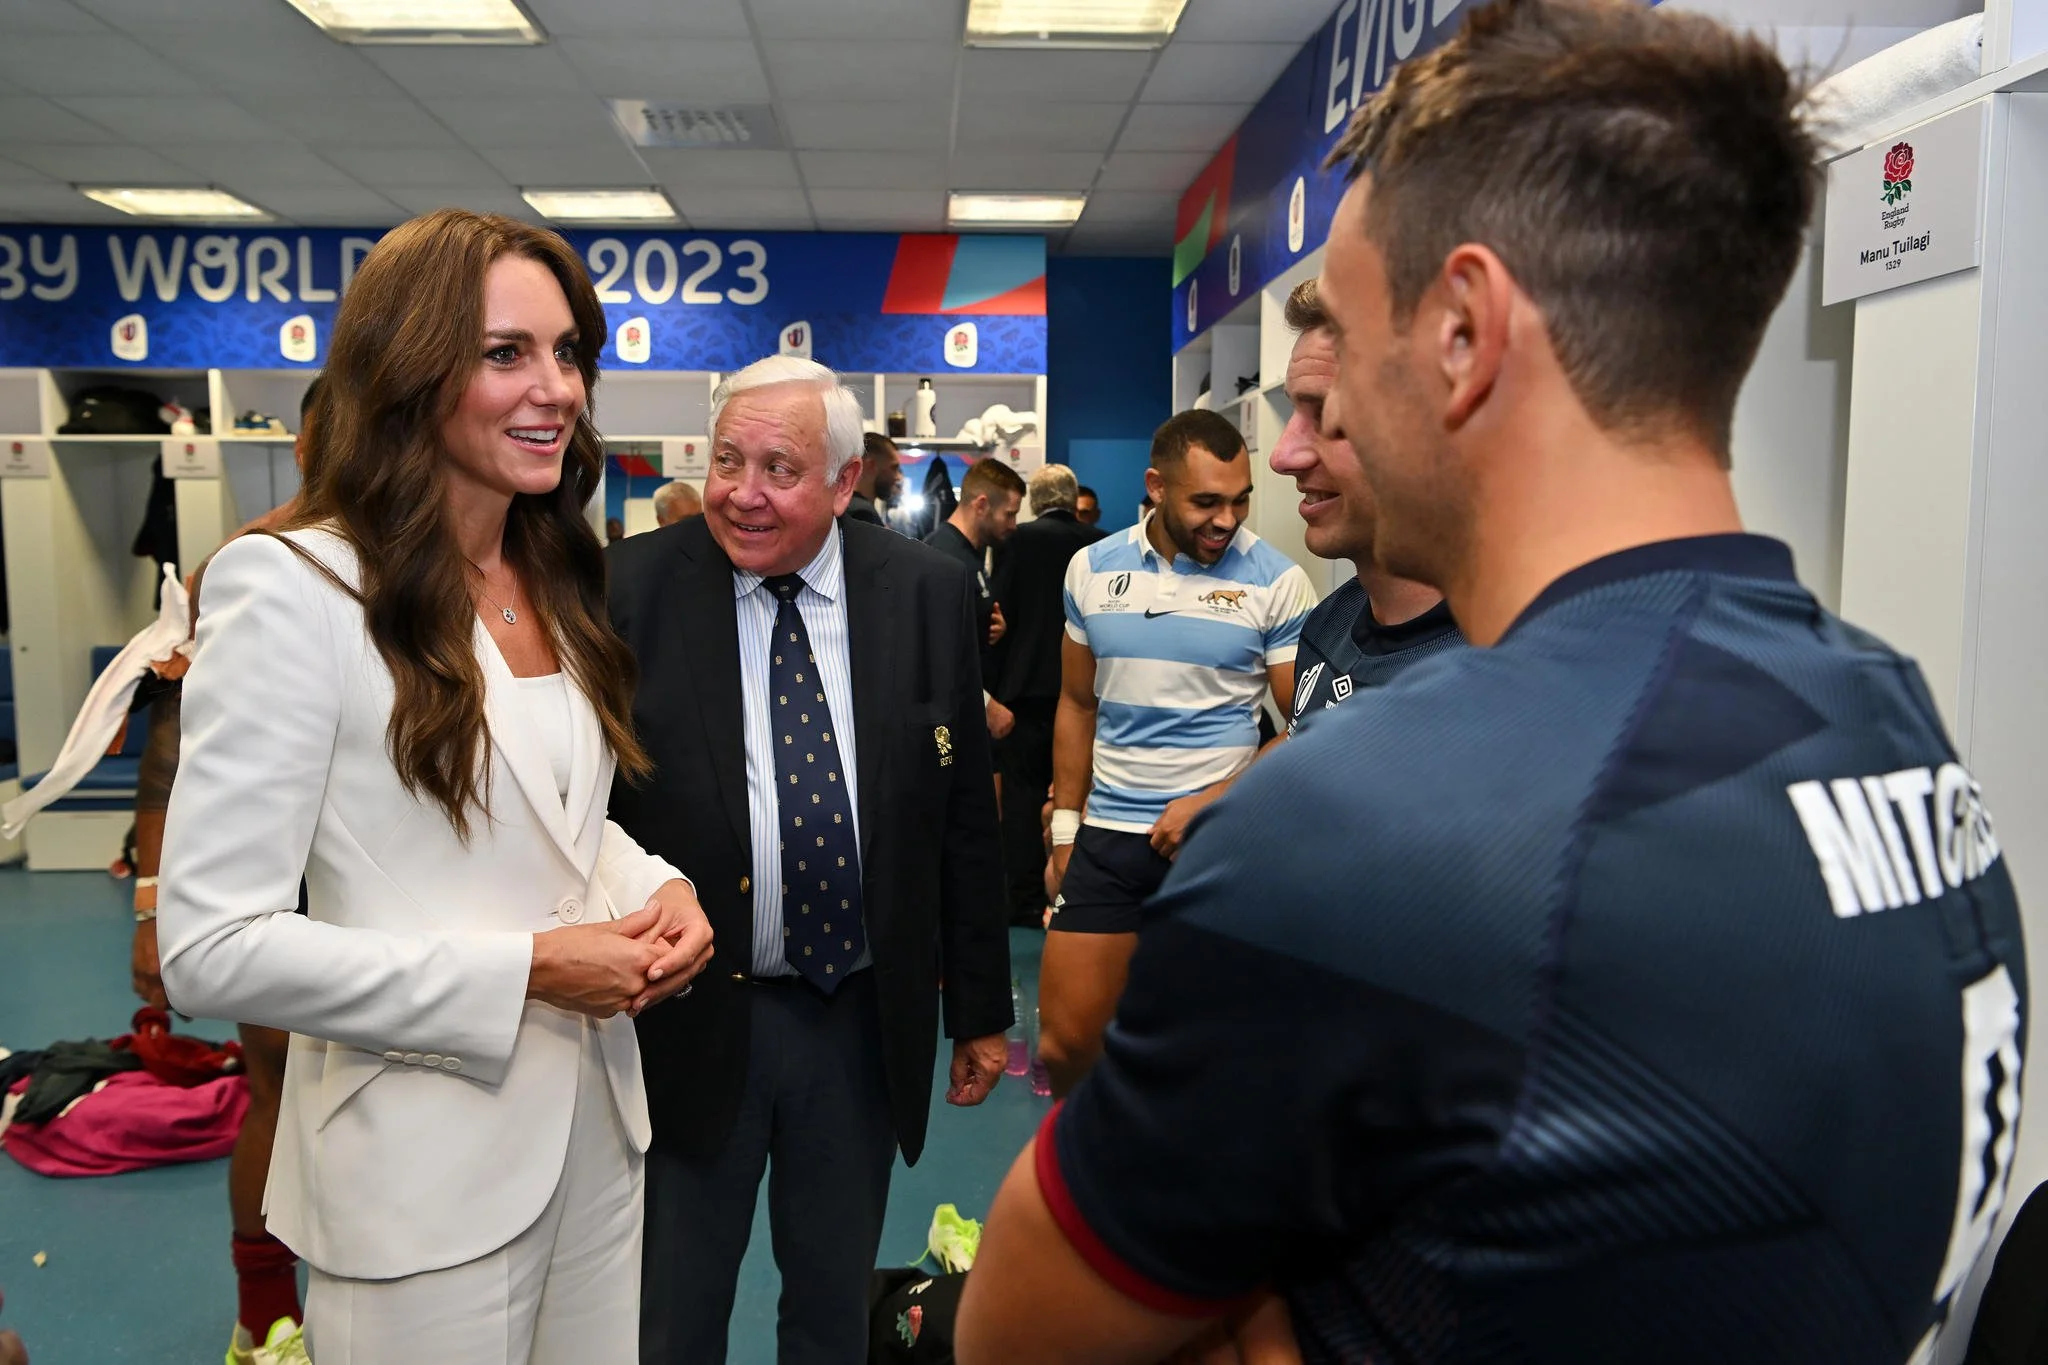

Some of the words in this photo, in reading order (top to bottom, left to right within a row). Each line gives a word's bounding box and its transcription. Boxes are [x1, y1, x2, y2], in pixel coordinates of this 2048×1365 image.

[1881, 203, 1909, 220] England
[1884, 216, 1905, 230] Rugby
[1860, 247, 1890, 265] Manu
[1892, 230, 1930, 255] Tuilagi
[588, 237, 769, 305] 2023
[1885, 258, 1901, 271] 1329
[1786, 762, 2001, 918] MITC
